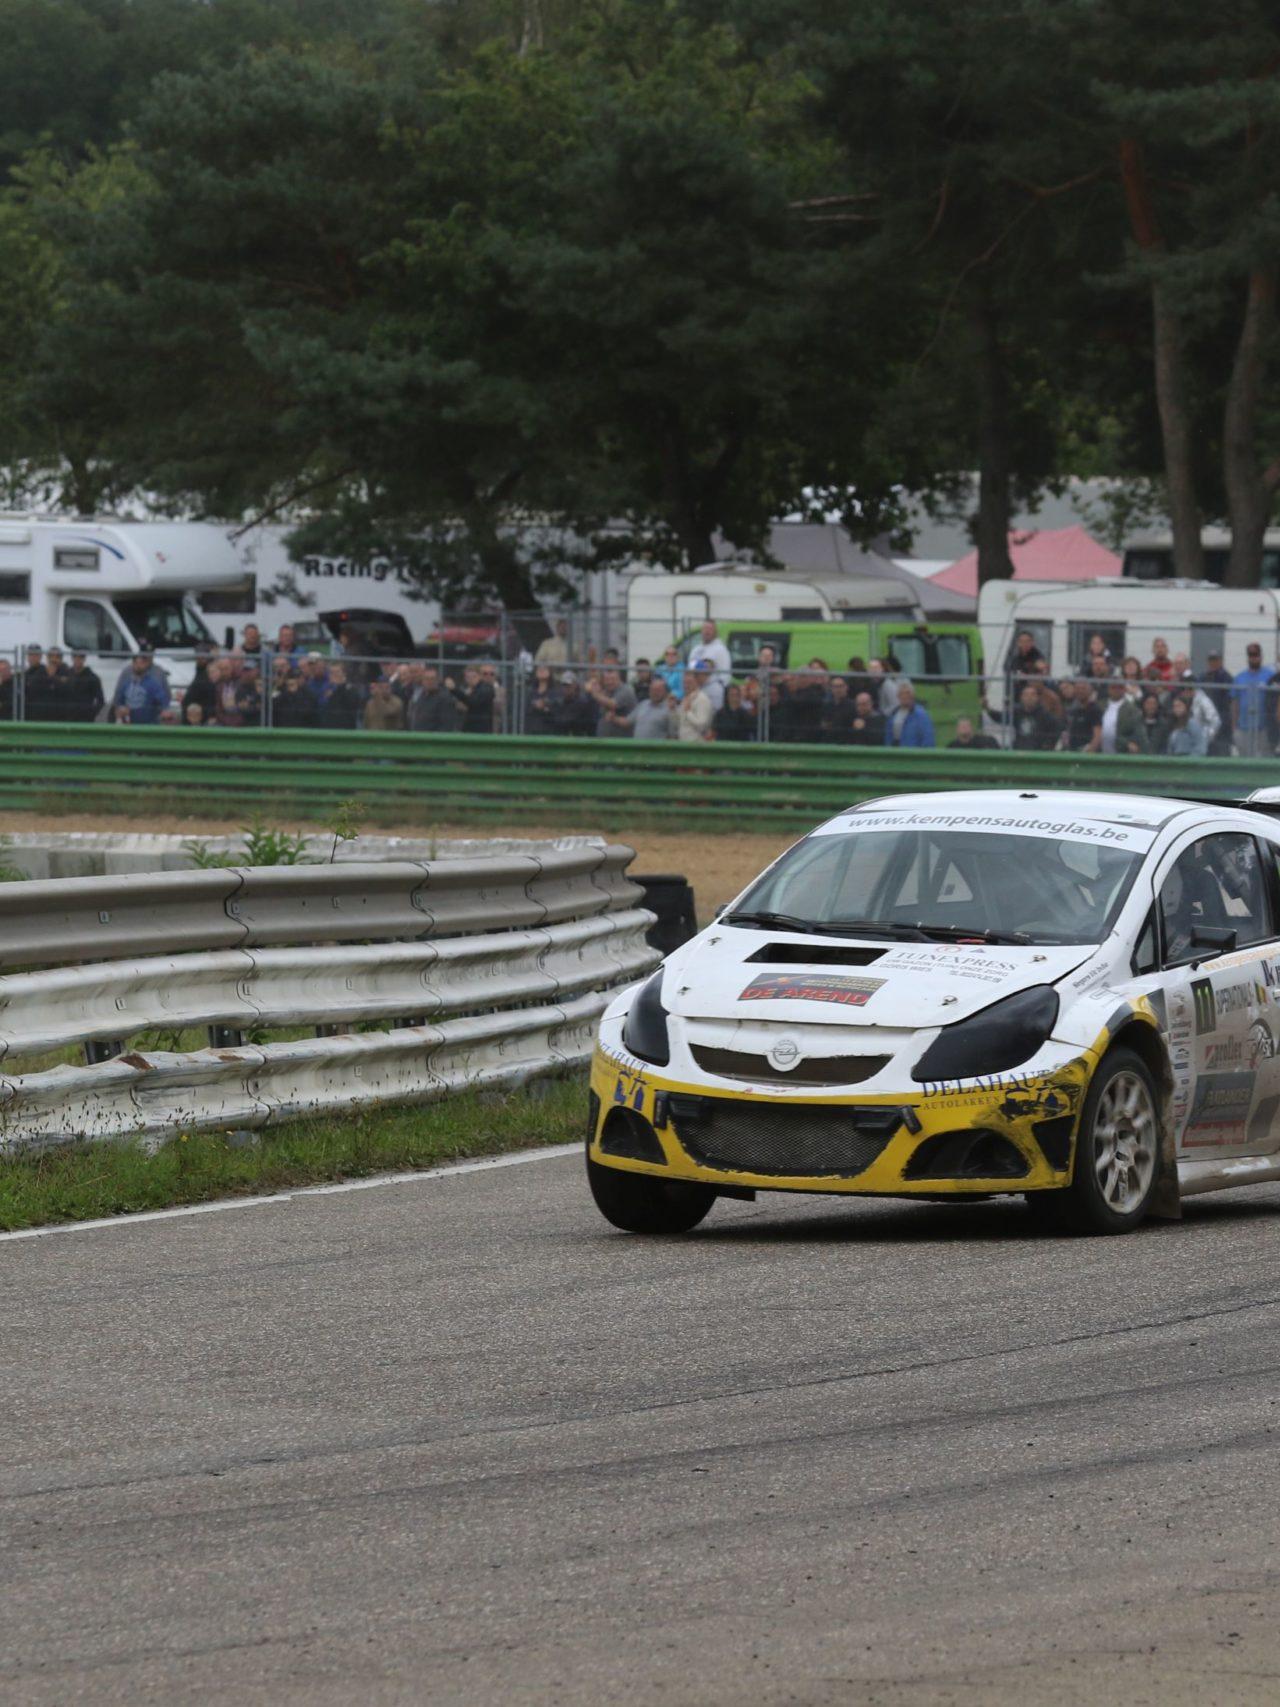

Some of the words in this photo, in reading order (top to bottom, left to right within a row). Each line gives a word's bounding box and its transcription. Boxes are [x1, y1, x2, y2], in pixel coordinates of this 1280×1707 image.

[849, 813, 1129, 842] www.kempensautoglas.be
[739, 987, 778, 1000] DE
[781, 987, 871, 1005] AREND
